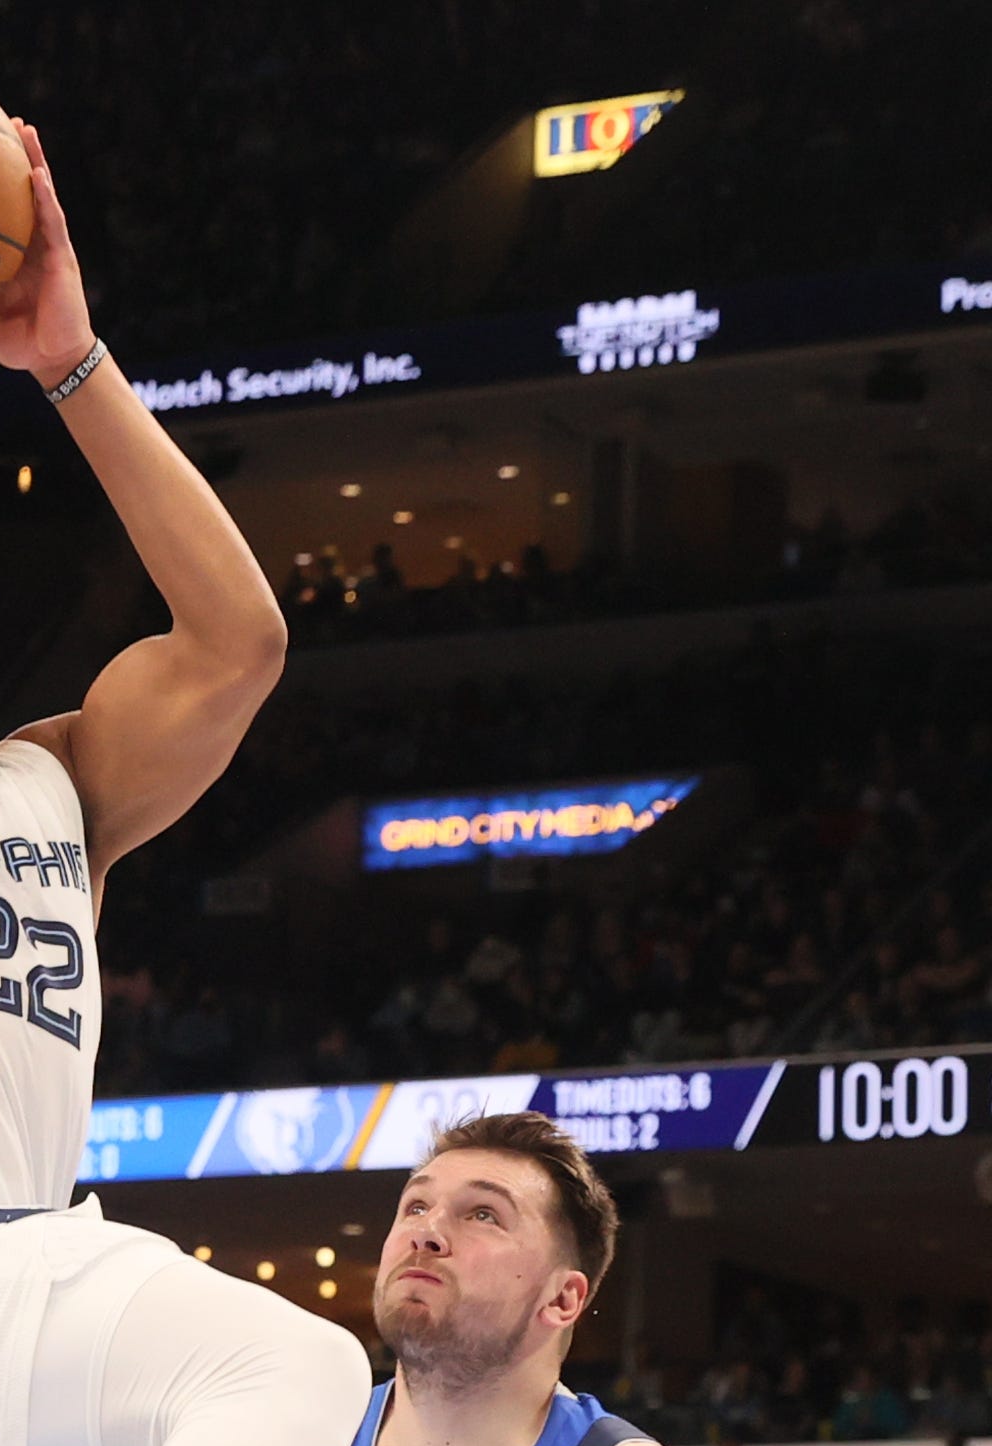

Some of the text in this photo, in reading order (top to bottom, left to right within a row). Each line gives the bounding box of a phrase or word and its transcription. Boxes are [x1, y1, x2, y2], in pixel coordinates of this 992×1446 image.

[226, 358, 359, 402] Security,
[363, 351, 422, 385] Inc.
[818, 1055, 969, 1143] 10:00
